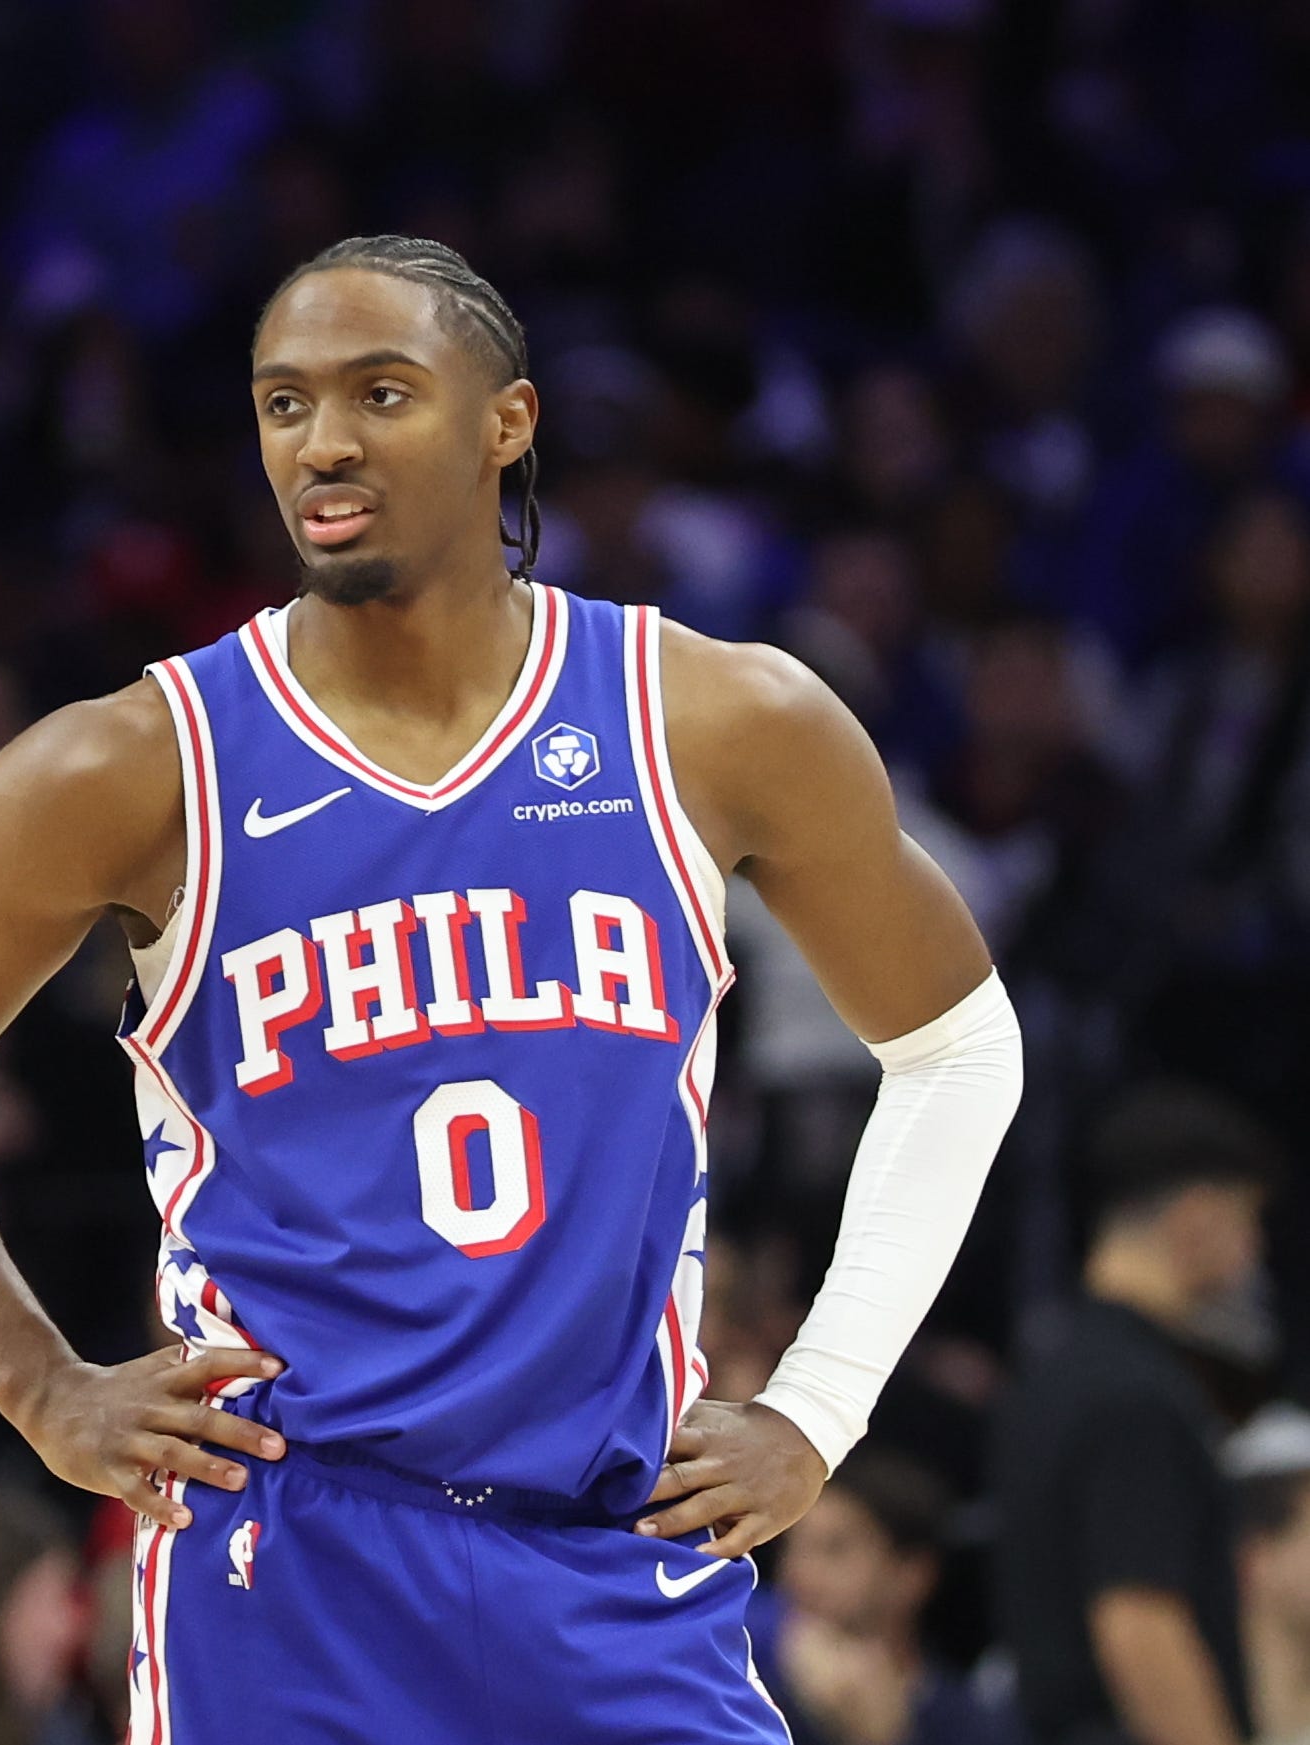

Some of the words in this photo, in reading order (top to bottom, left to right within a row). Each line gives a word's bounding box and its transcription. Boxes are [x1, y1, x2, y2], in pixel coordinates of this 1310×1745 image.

[513, 798, 634, 822] crypto.com
[221, 888, 680, 1097] PHILA
[413, 1079, 546, 1259] 0
